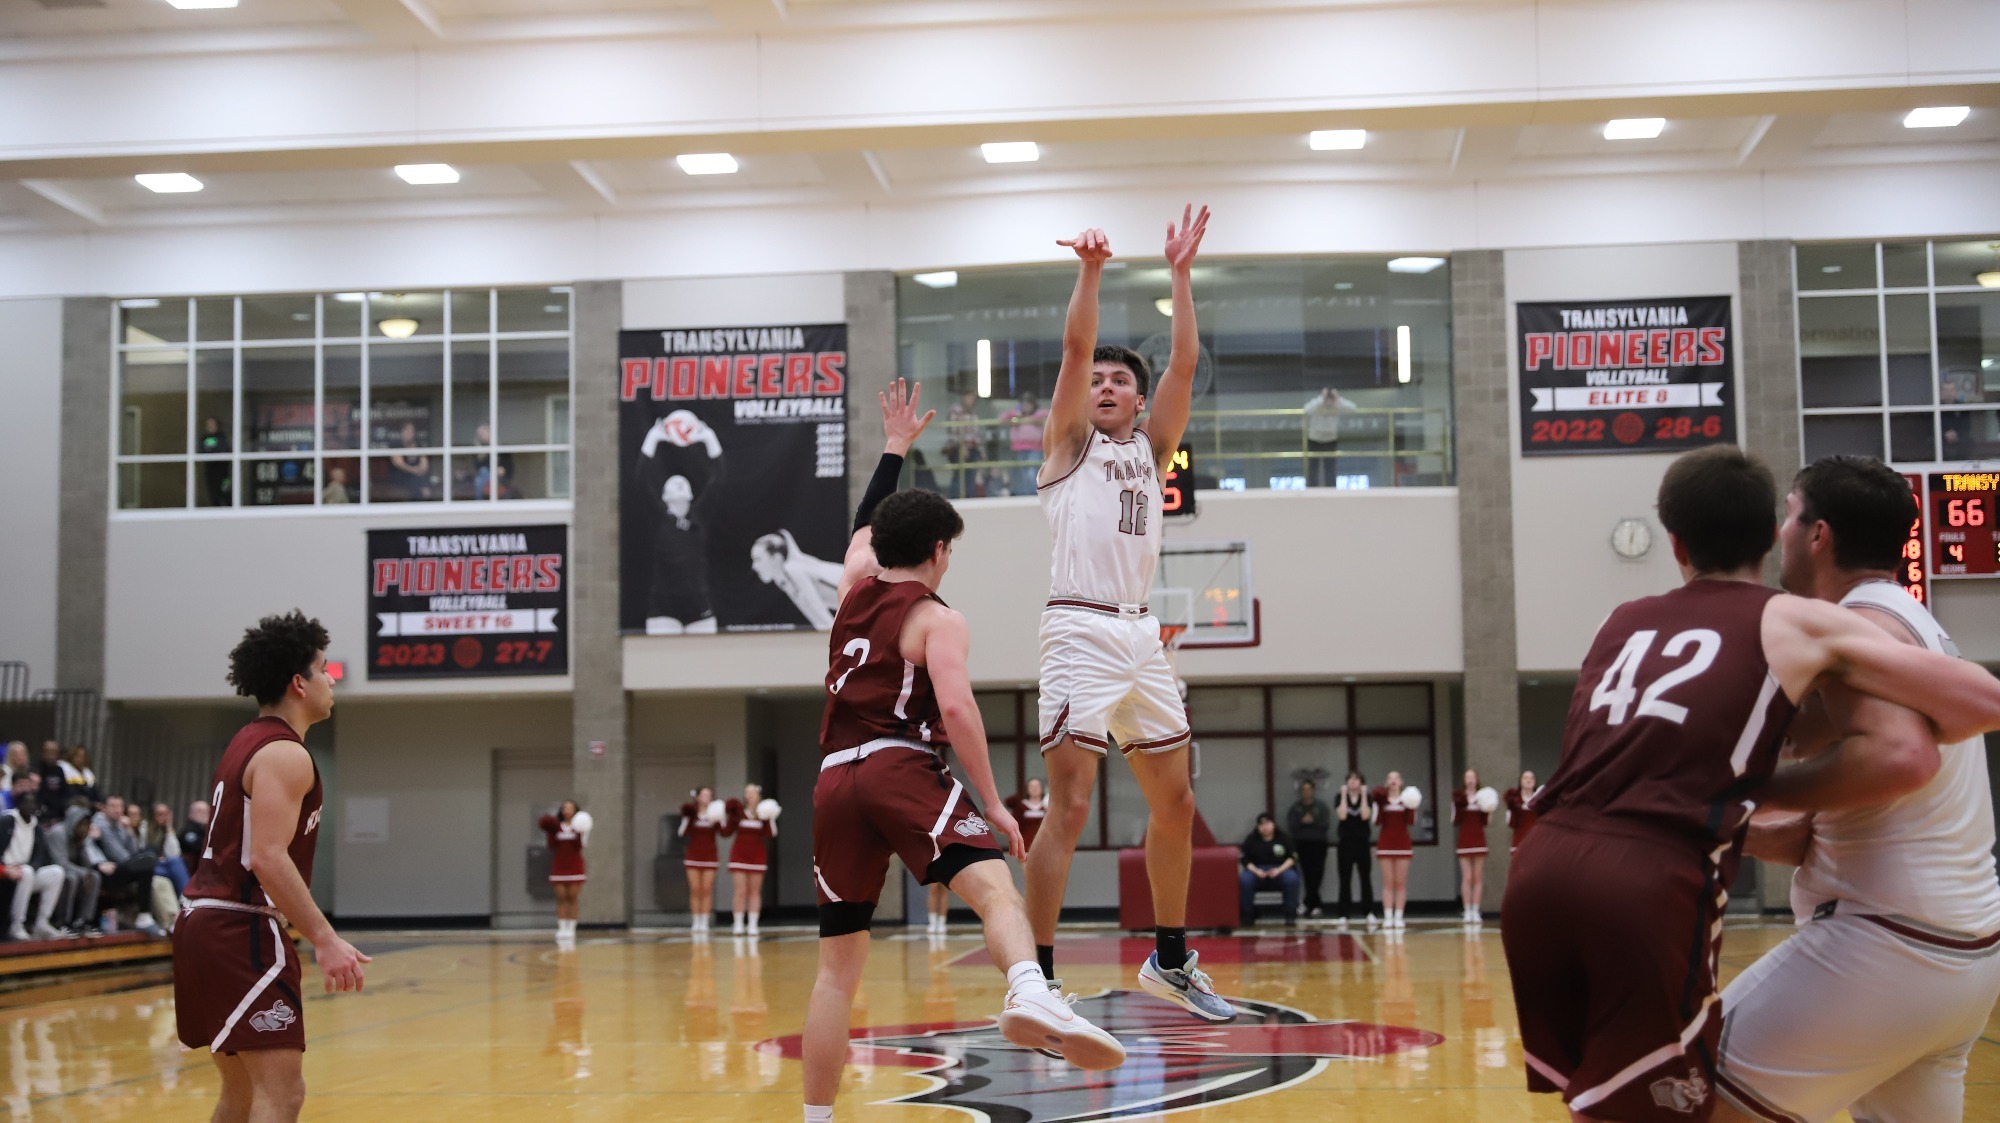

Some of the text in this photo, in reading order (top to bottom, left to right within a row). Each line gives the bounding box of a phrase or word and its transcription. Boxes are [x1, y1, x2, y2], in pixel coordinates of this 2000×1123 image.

[1561, 306, 1688, 329] TRANSYLVANIA
[661, 327, 805, 353] TRANSYLVANIA
[1525, 327, 1725, 371] PIONEERS
[621, 351, 845, 401] PIONEERS
[1586, 369, 1669, 386] VOLLEYBALL
[734, 398, 844, 417] VOLLEYBALL
[1588, 390, 1668, 405] ELITE 8
[1531, 419, 1605, 442] 2022
[1655, 416, 1721, 439] 28-6
[1943, 474, 1999, 491] TRANSY
[1119, 489, 1149, 535] 12
[1948, 499, 1984, 527] 66
[407, 533, 527, 556] TRANSYLVANIA
[1949, 545, 1963, 562] 4
[373, 554, 562, 597] PIONEERS
[1908, 562, 1922, 582] 6
[423, 614, 513, 631] SWEET 16
[376, 643, 446, 666] 2023
[1589, 628, 1722, 725] 42
[202, 780, 225, 860] 2
